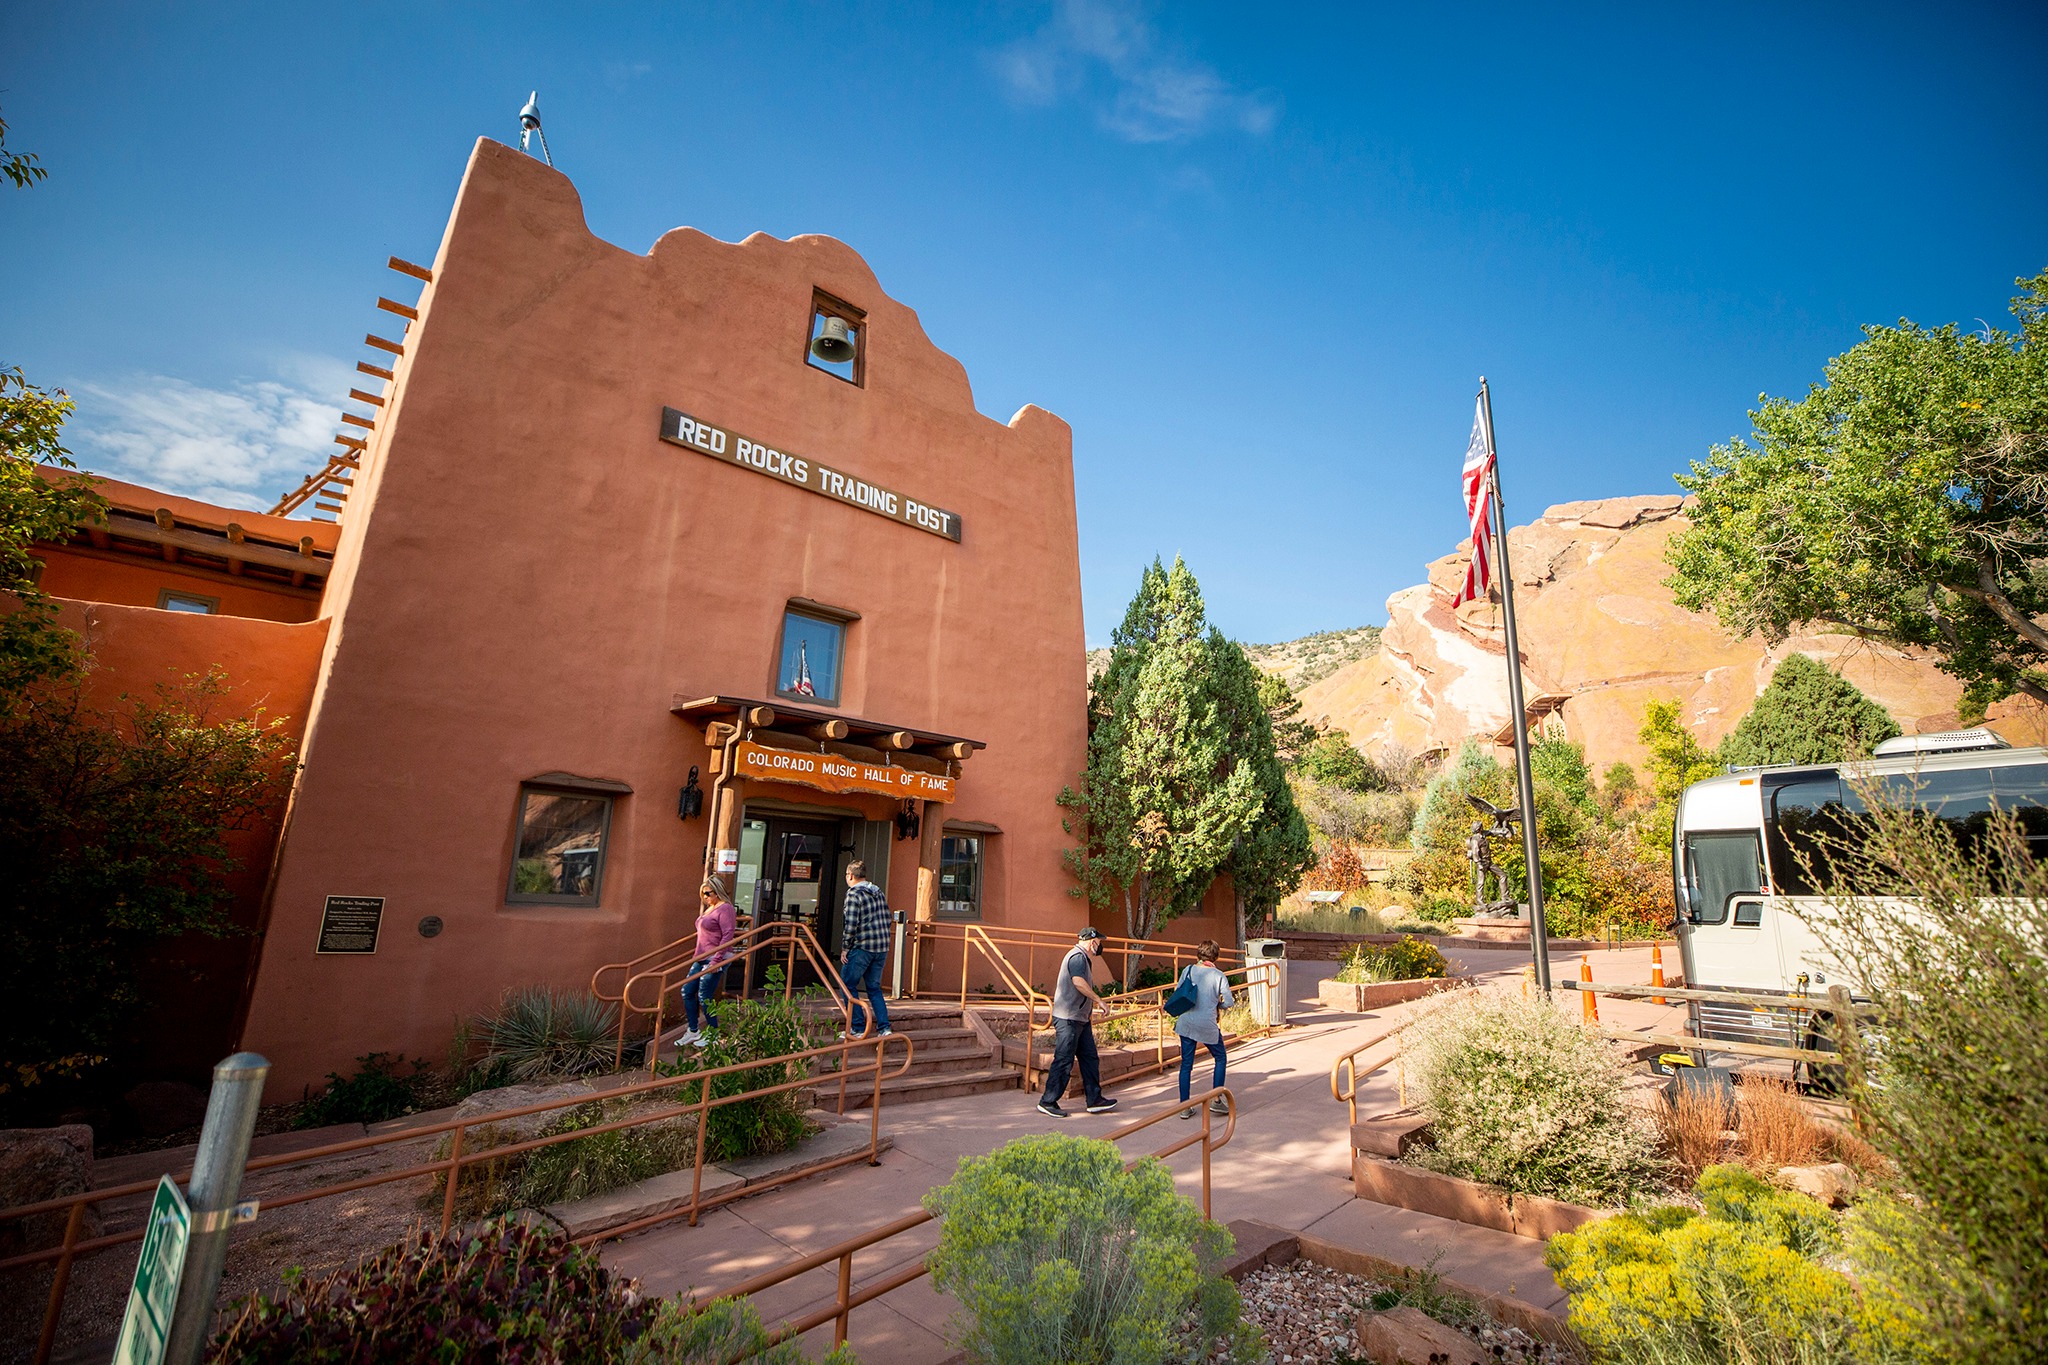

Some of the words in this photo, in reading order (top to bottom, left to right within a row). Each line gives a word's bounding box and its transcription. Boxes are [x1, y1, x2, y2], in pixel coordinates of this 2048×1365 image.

[678, 416, 726, 454] RED
[736, 438, 809, 483] ROCKS
[818, 467, 898, 515] TRADING
[905, 499, 950, 533] POST
[747, 752, 815, 773] COLORADO
[822, 762, 857, 778] MUSIC
[864, 768, 893, 784] HALL
[900, 773, 915, 786] OF
[920, 776, 949, 791] FAME
